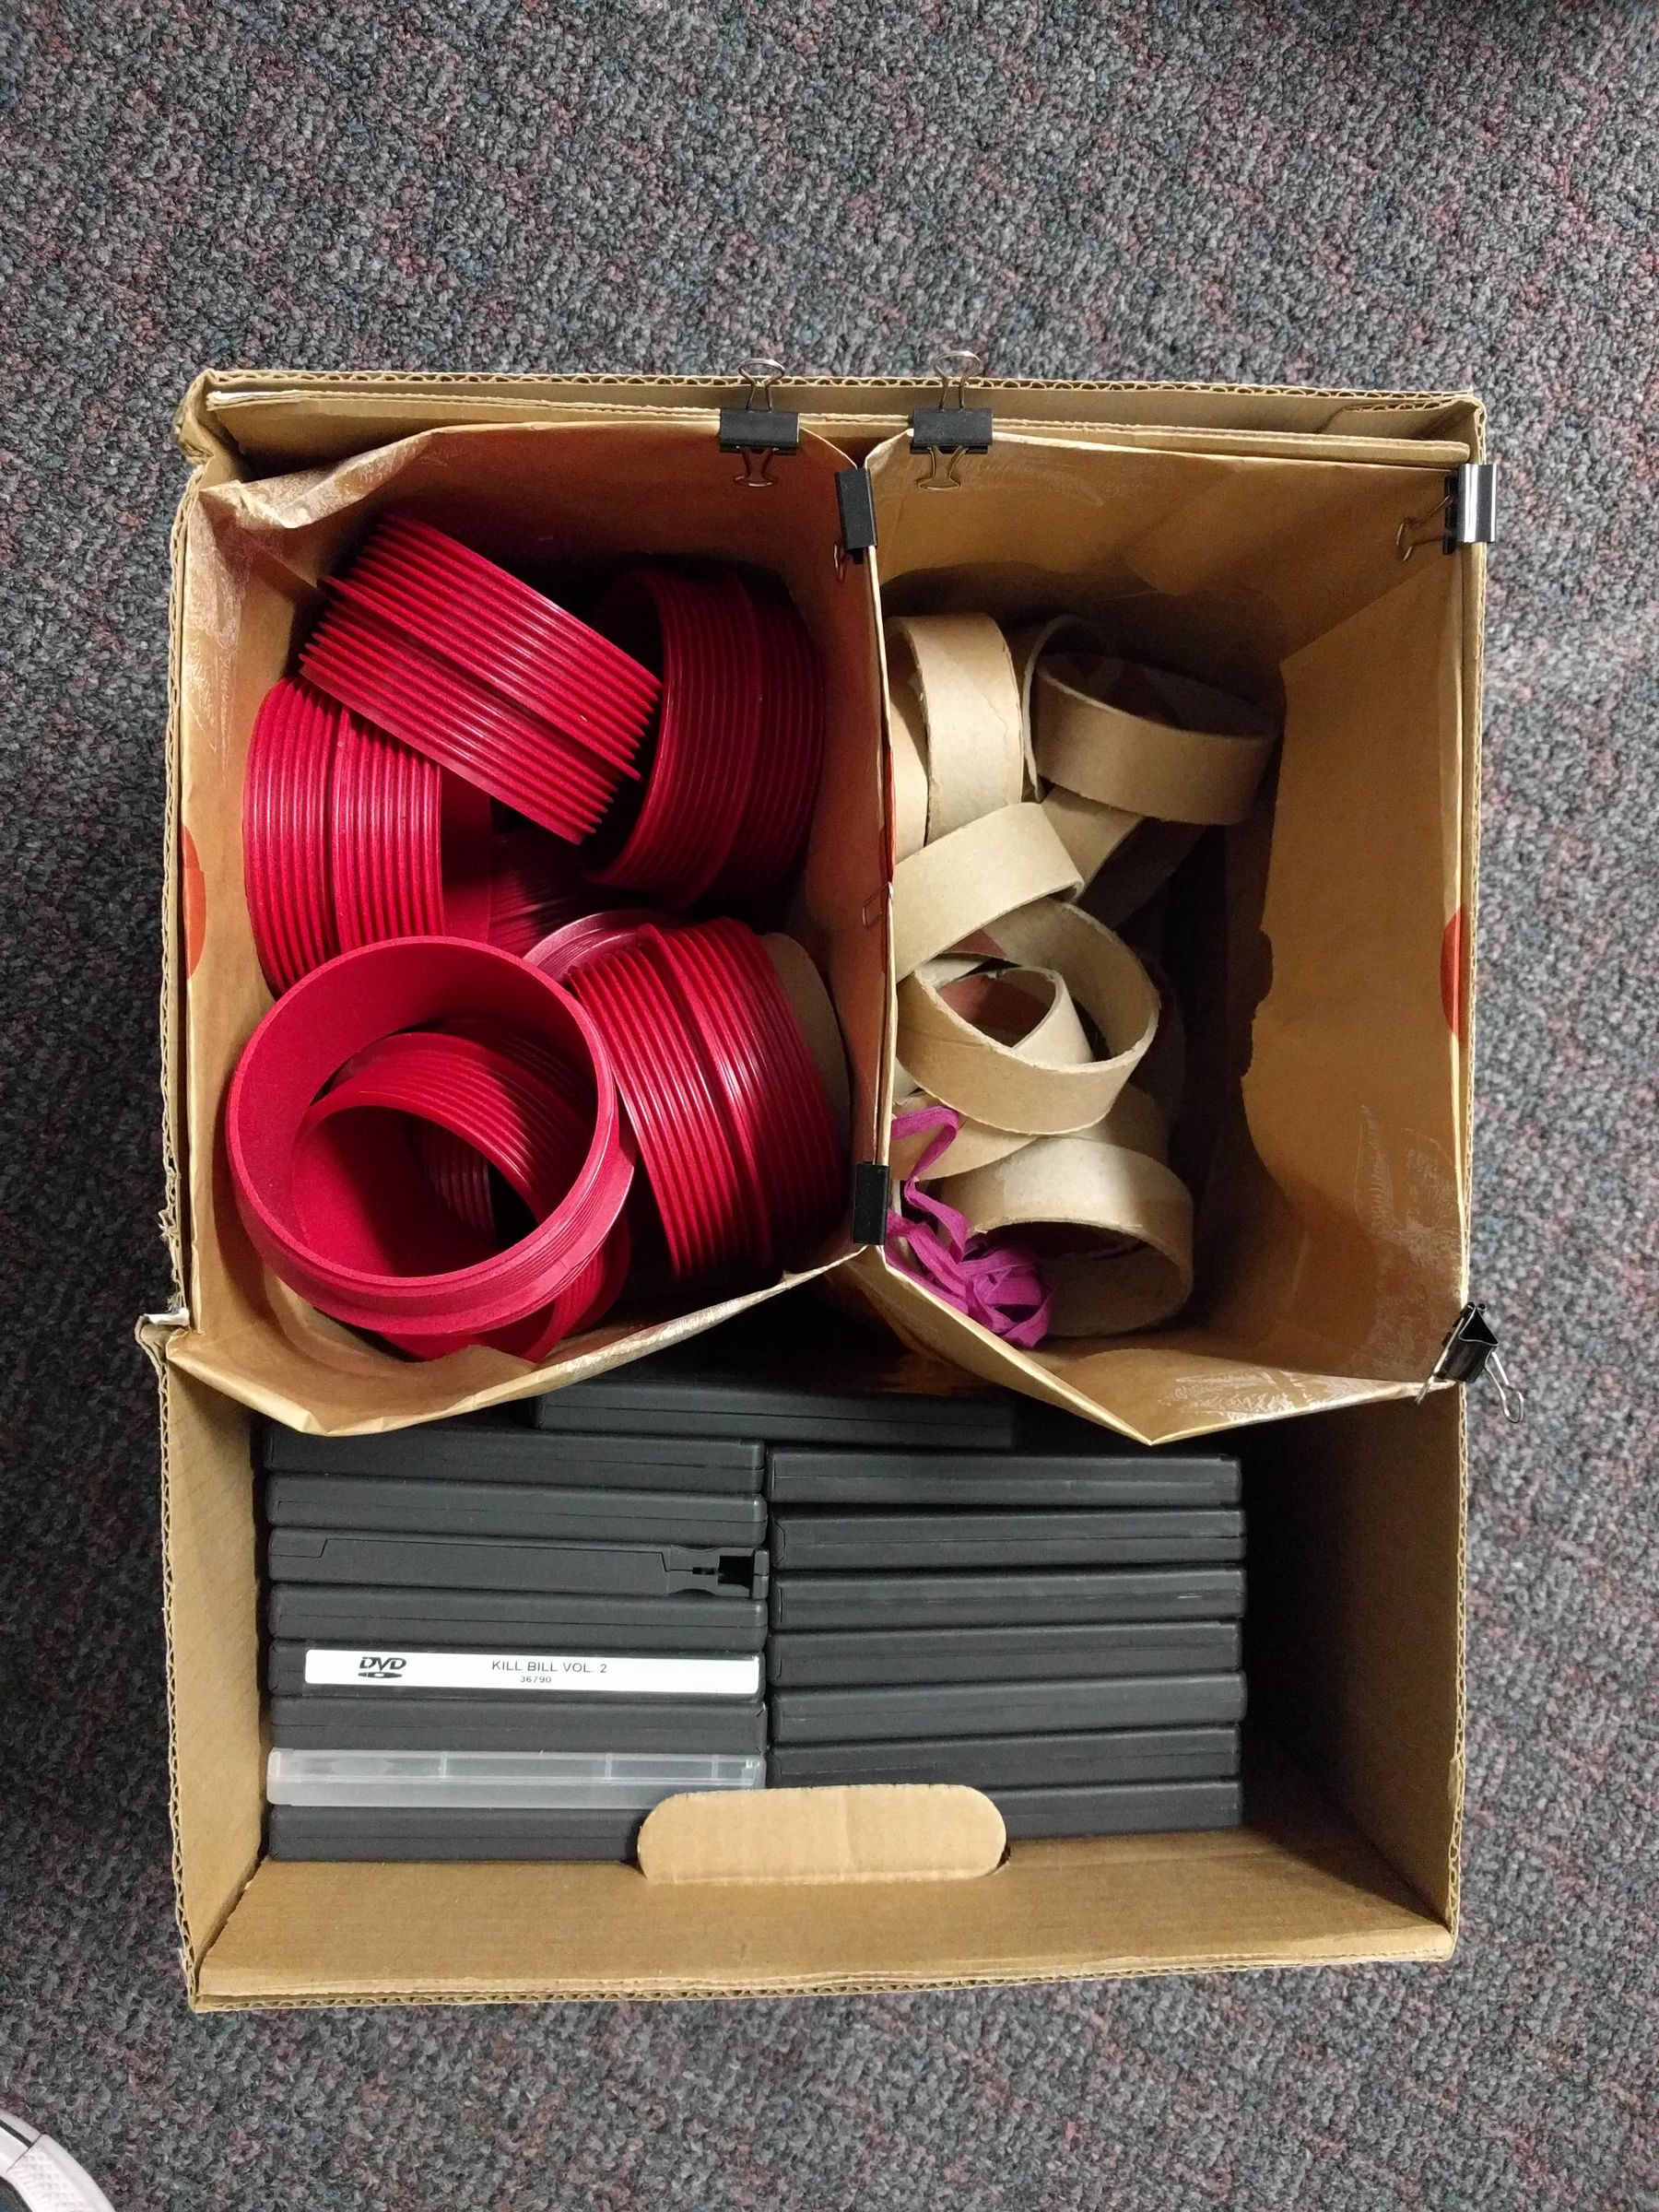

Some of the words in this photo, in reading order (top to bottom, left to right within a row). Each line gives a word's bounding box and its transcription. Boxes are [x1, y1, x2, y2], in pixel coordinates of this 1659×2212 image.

[359, 1656, 407, 1672] DVD
[491, 1660, 523, 1671] KILL
[527, 1661, 558, 1672] BILL
[563, 1662, 594, 1673] VOL.
[600, 1663, 607, 1673] 2
[520, 1675, 552, 1684] 36790
